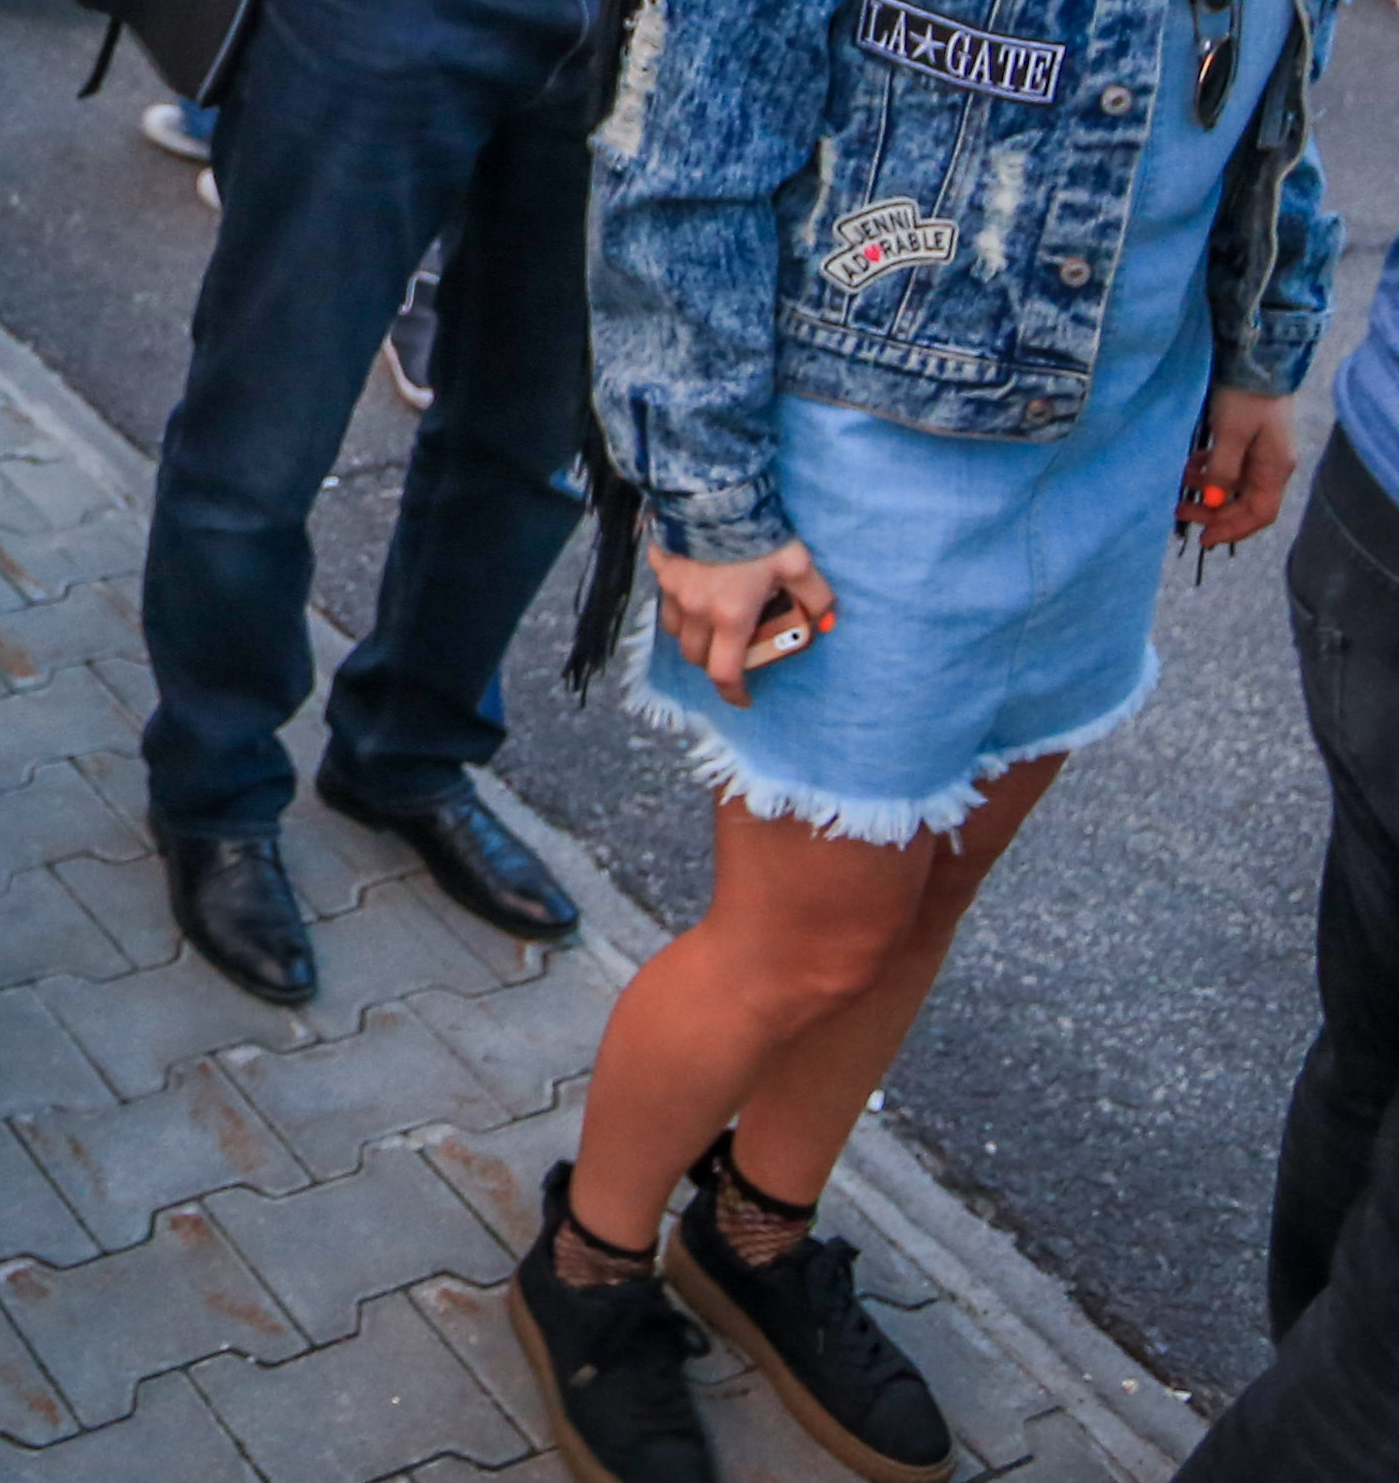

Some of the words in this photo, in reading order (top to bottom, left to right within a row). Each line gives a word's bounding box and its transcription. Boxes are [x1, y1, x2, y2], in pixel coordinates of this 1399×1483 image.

[865, 0, 908, 59] LA
[945, 29, 1053, 95] GATE
[854, 209, 913, 246] JENNI
